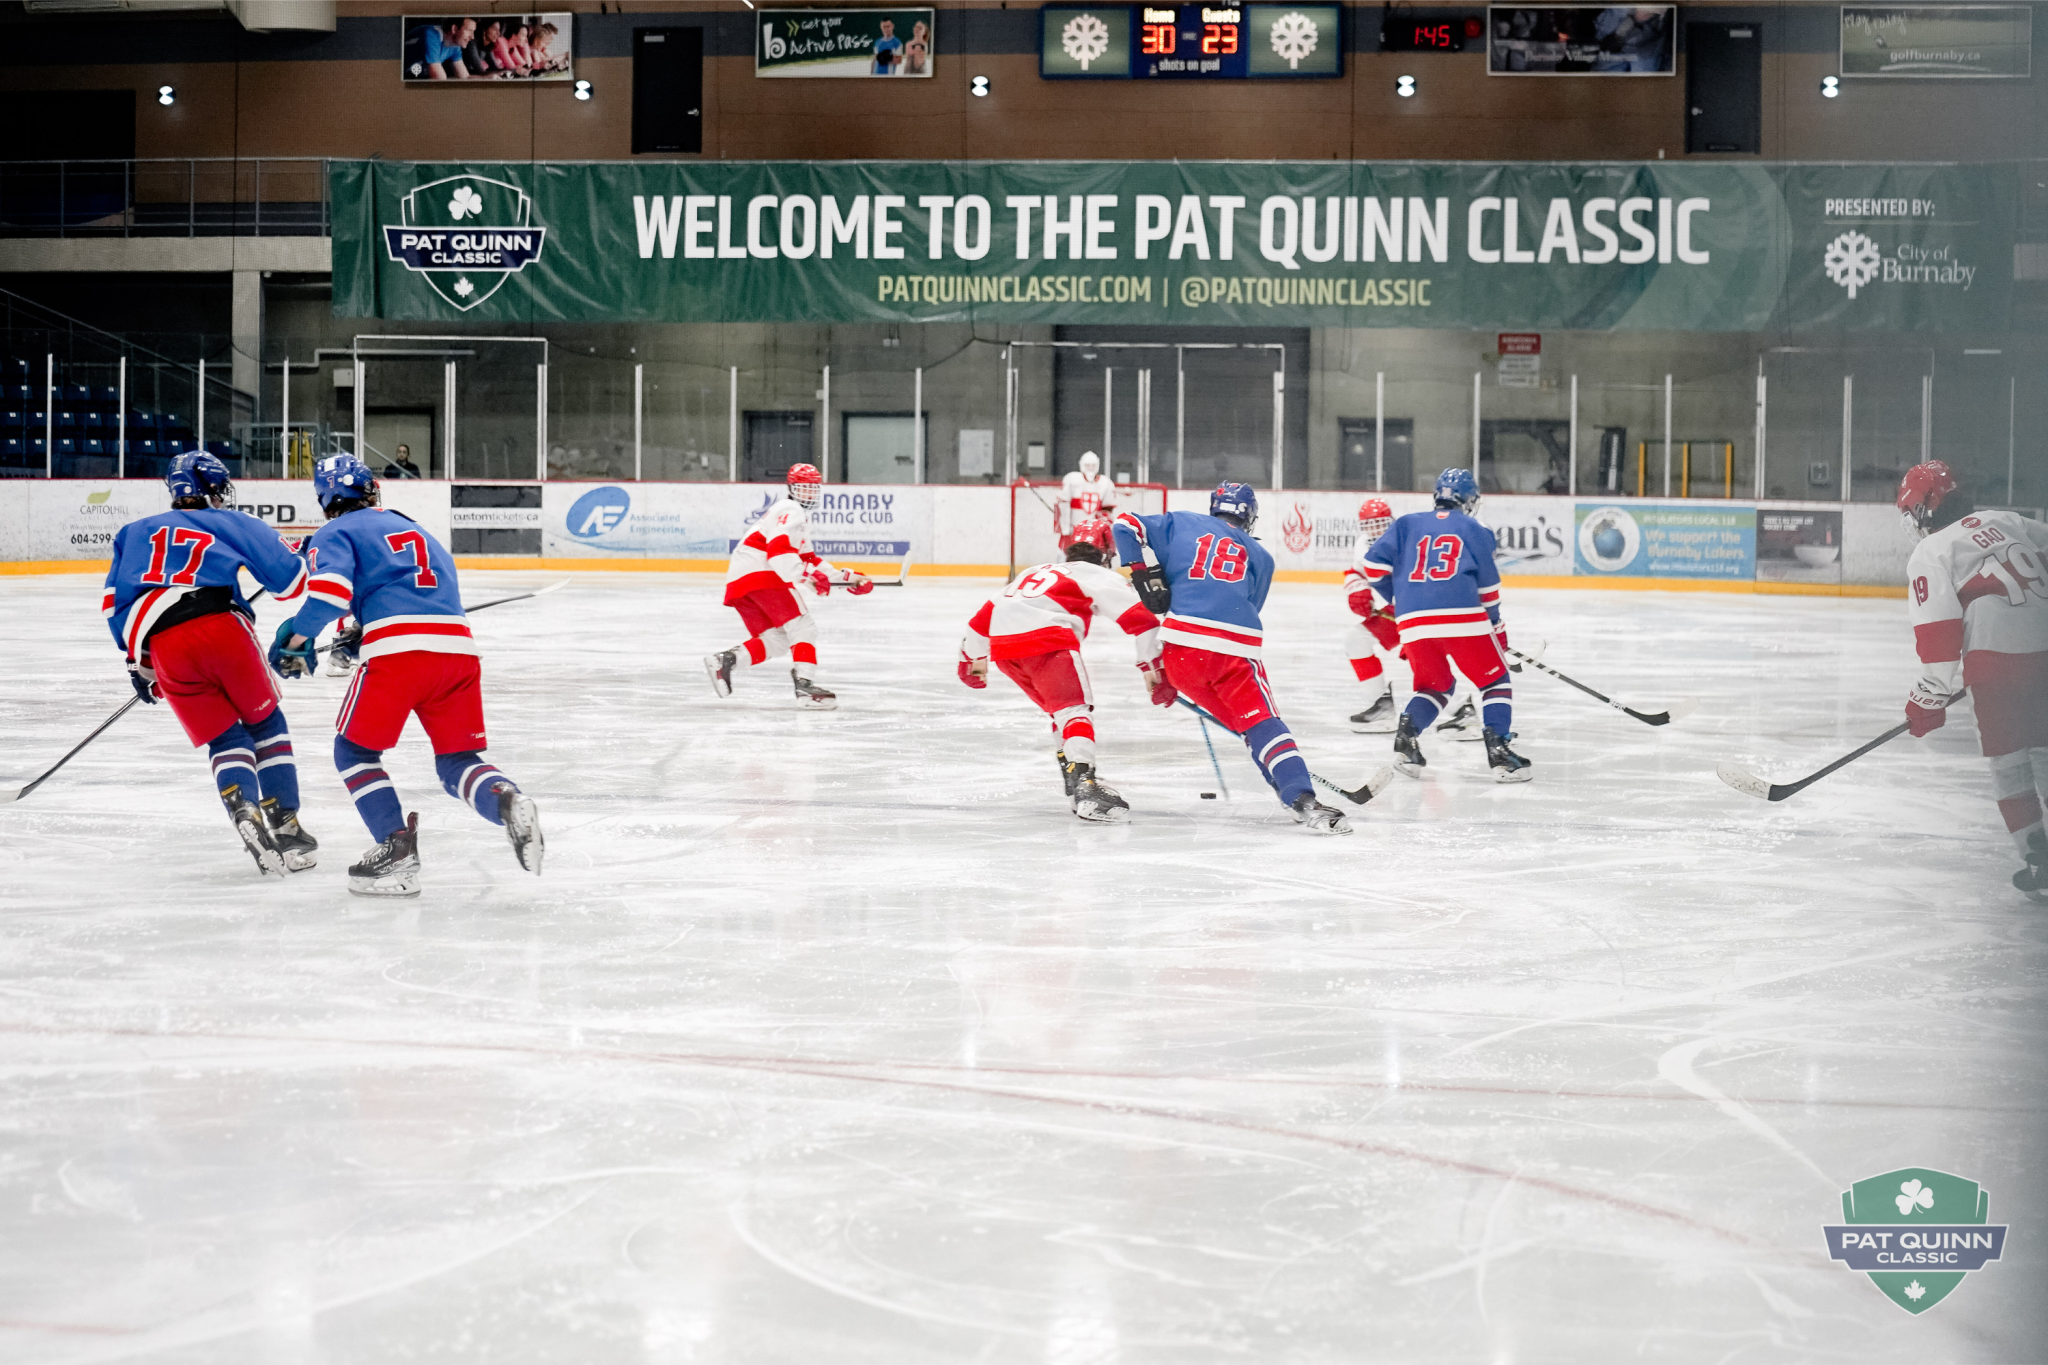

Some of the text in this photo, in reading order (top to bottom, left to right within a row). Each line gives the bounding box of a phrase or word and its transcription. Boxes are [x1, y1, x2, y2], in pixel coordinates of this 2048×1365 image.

[1143, 7, 1175, 23] Home
[1142, 25, 1238, 54] 30 23
[1414, 25, 1450, 47] 1:45
[1159, 58, 1220, 73] shots on goal
[1890, 49, 1981, 62] golfburnaby.ca
[1825, 198, 1935, 217] PRESENTED BY:
[633, 194, 1711, 269] WELCOME TO THE PAT QUINN CLASSIC
[401, 234, 532, 251] PAT QUINN
[431, 252, 502, 264] CLASSIC
[1897, 243, 1950, 265] City of
[1882, 257, 1976, 291] Burnaby
[878, 275, 1152, 303] PATQUINNCLASSIC.COM
[1180, 277, 1432, 309] @PATQUINNCLASSIC
[823, 493, 894, 510] RNABY
[630, 514, 681, 522] Associated
[811, 511, 894, 524] ATING CLUB
[1316, 517, 1358, 532] BURNA
[71, 533, 115, 545] 604-299-
[630, 525, 687, 535] Engineering
[1497, 515, 1564, 558] an's
[1669, 531, 1719, 544] support
[1721, 531, 1741, 543] the
[1972, 527, 2006, 549] GAO
[814, 542, 895, 555] burnaby.ca
[1316, 534, 1356, 548] FIREFI
[140, 526, 216, 588] 17
[308, 547, 320, 573] 7
[384, 530, 439, 589] 7
[1188, 533, 1249, 583] 18
[1408, 534, 1464, 583] 13
[1978, 542, 2048, 607] 19
[1913, 575, 1929, 607] 19
